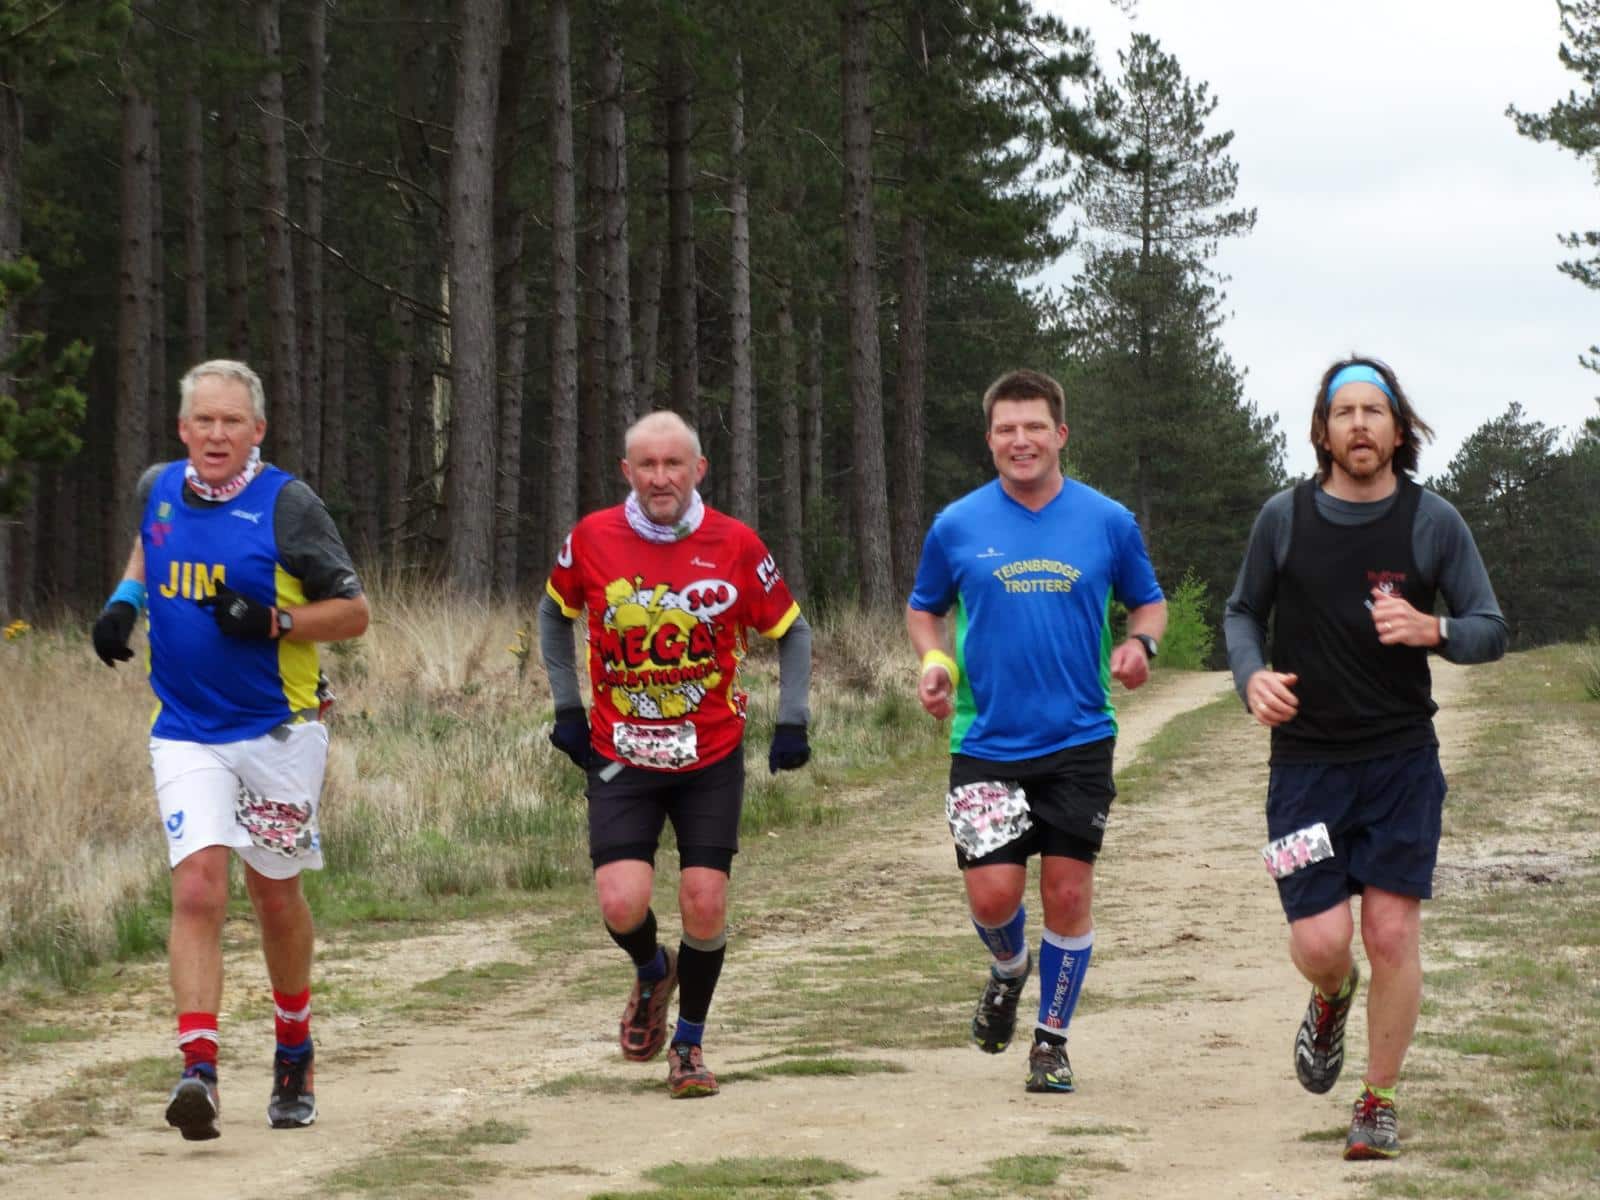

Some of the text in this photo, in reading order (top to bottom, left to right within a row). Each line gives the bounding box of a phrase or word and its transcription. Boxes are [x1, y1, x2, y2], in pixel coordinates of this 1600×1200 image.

[160, 561, 225, 600] JIM
[992, 558, 1082, 582] TEIGNBRIDGE
[1004, 580, 1072, 593] TROTTERS
[600, 623, 714, 667] MEGA
